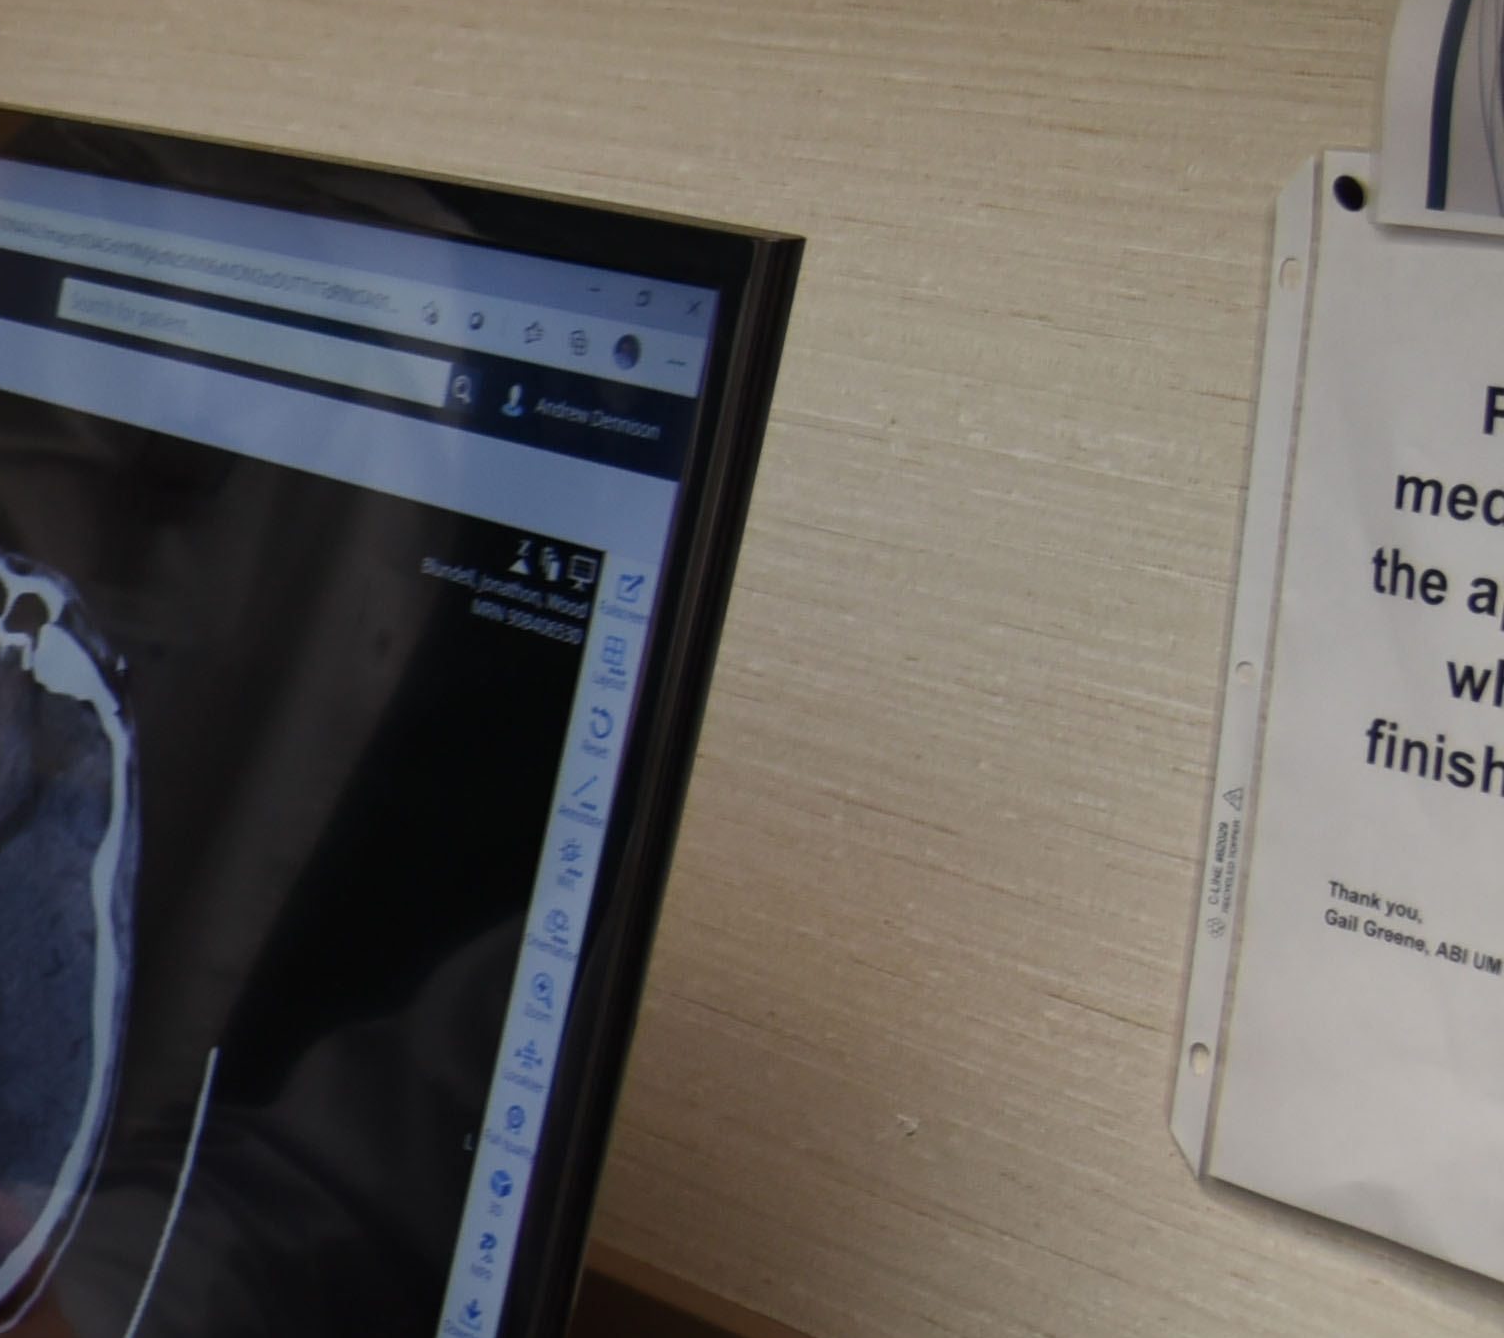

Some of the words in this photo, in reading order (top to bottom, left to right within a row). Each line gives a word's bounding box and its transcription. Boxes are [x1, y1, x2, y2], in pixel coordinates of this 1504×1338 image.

[1372, 546, 1448, 606] the
[1467, 576, 1504, 633] a
[1328, 879, 1381, 911] Thank
[1385, 899, 1423, 925] you,
[1324, 908, 1358, 934] Gail
[1363, 918, 1430, 957] Greene,
[1436, 939, 1468, 967] ABI
